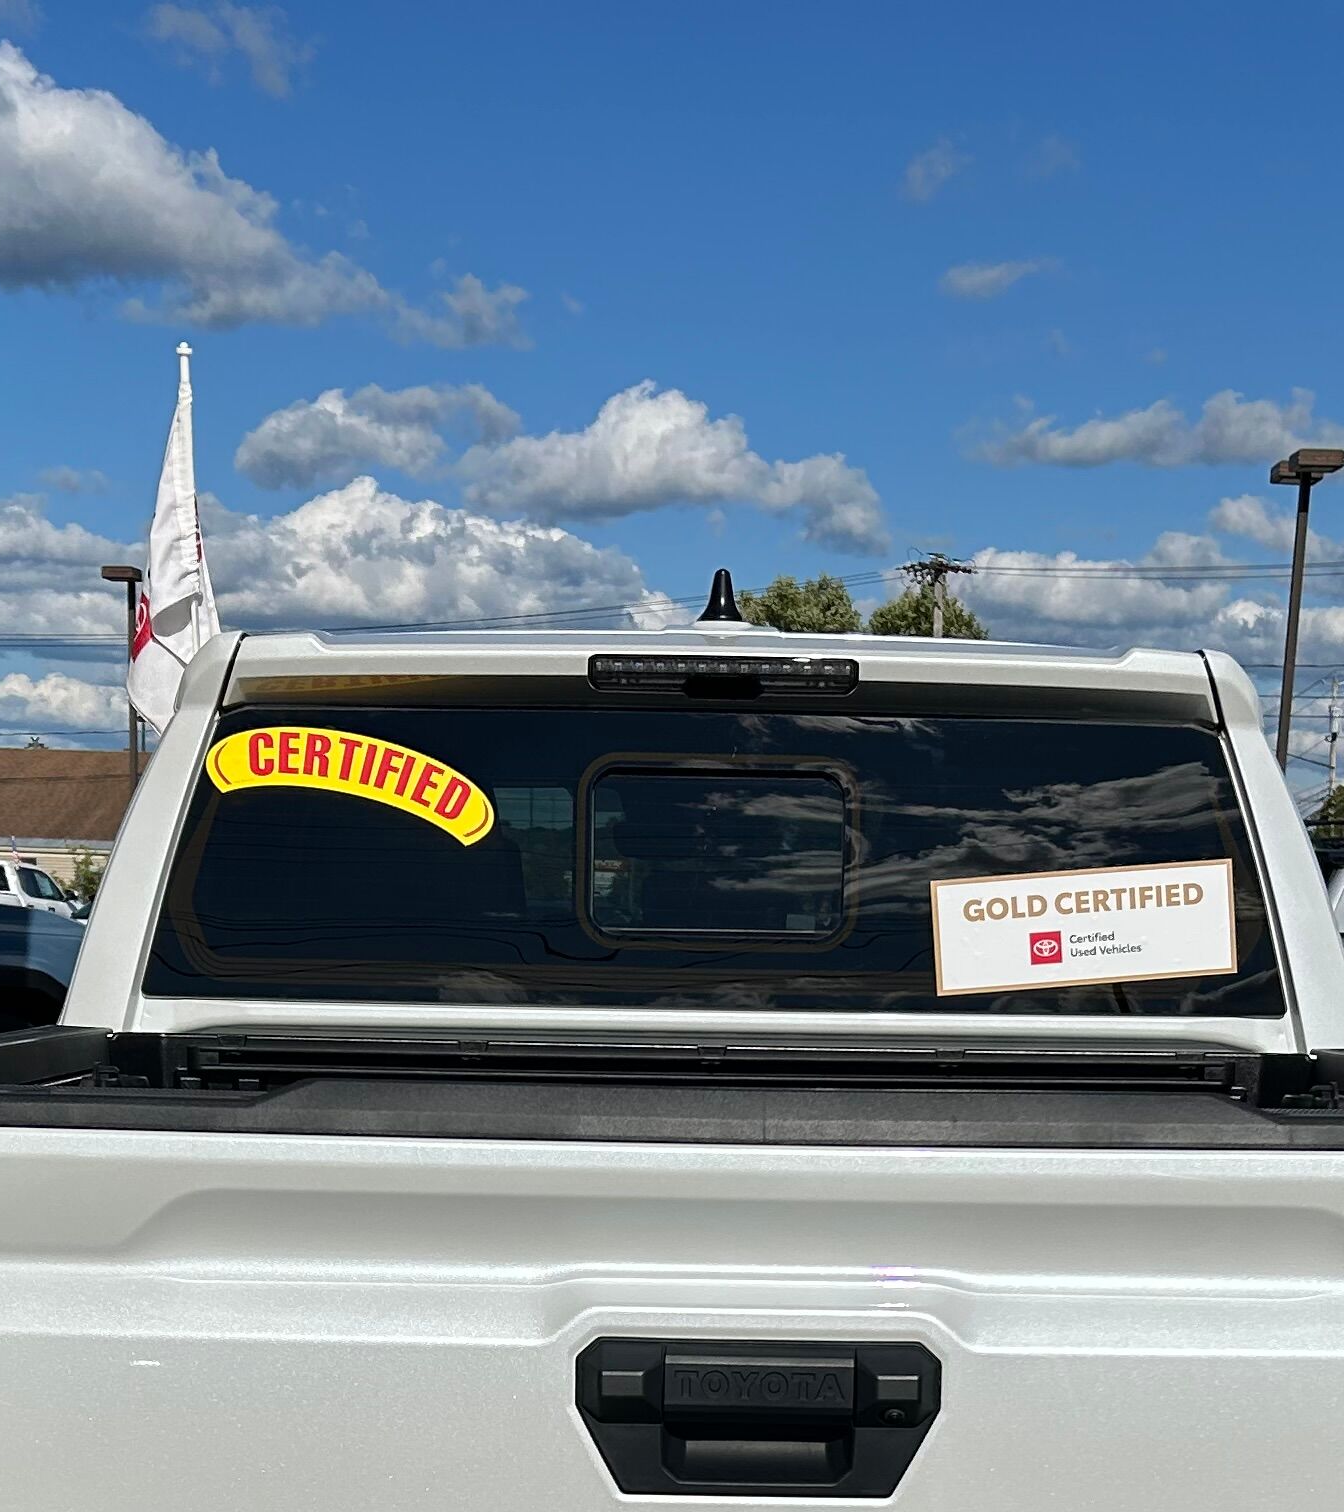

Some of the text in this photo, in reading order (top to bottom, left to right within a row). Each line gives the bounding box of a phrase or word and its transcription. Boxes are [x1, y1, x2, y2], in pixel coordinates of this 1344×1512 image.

[249, 732, 472, 820] CERTIFIED
[963, 883, 1204, 922] GOLD CERTIFIED
[1069, 931, 1115, 944] Certified
[1070, 943, 1142, 957] Used Vehicles
[674, 1369, 846, 1401] TOYOTA
